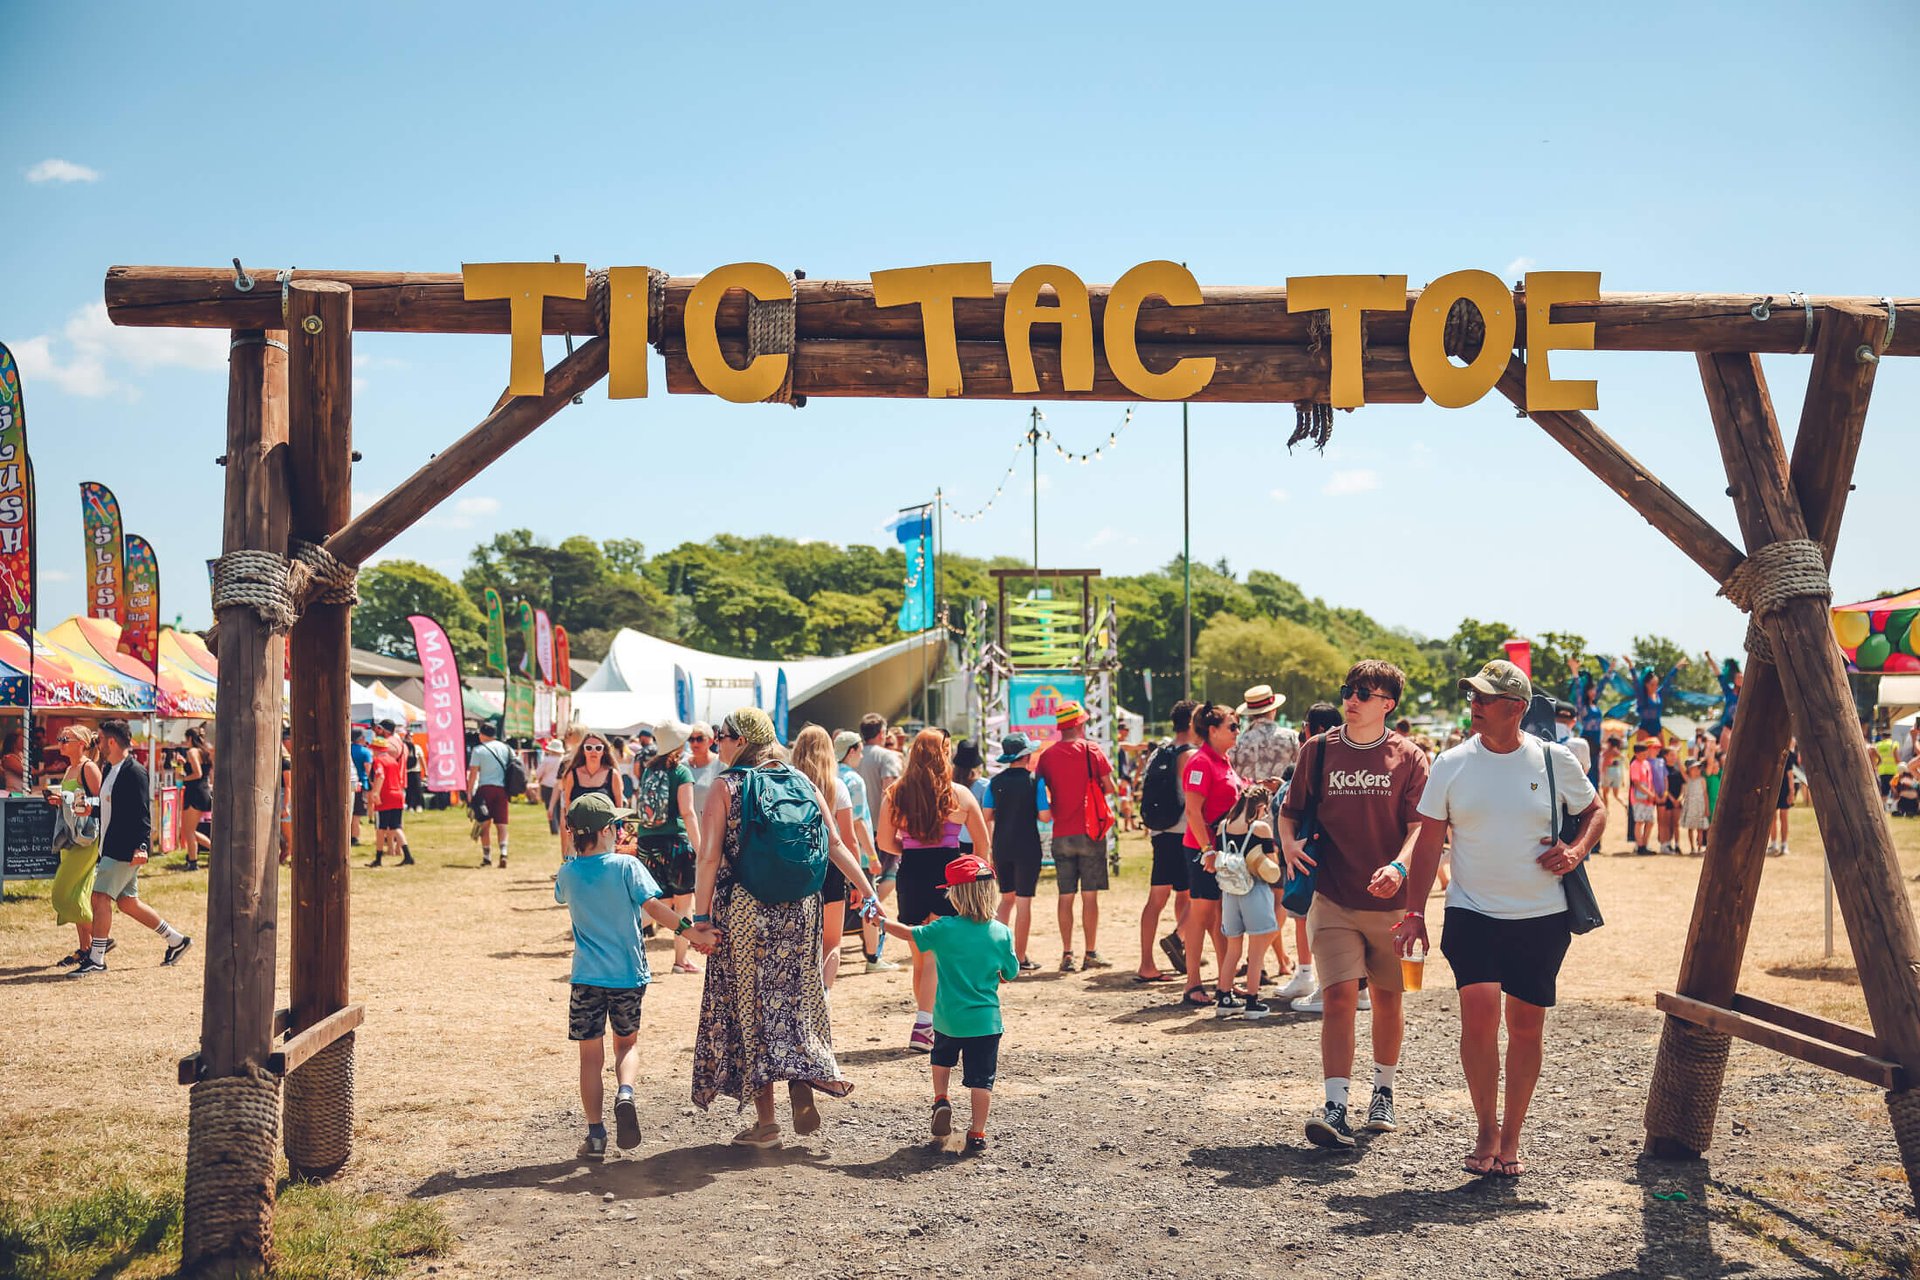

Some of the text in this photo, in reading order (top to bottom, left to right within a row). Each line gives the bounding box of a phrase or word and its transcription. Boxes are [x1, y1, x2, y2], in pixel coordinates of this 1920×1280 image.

[462, 260, 1602, 411] TIC TAC TOE
